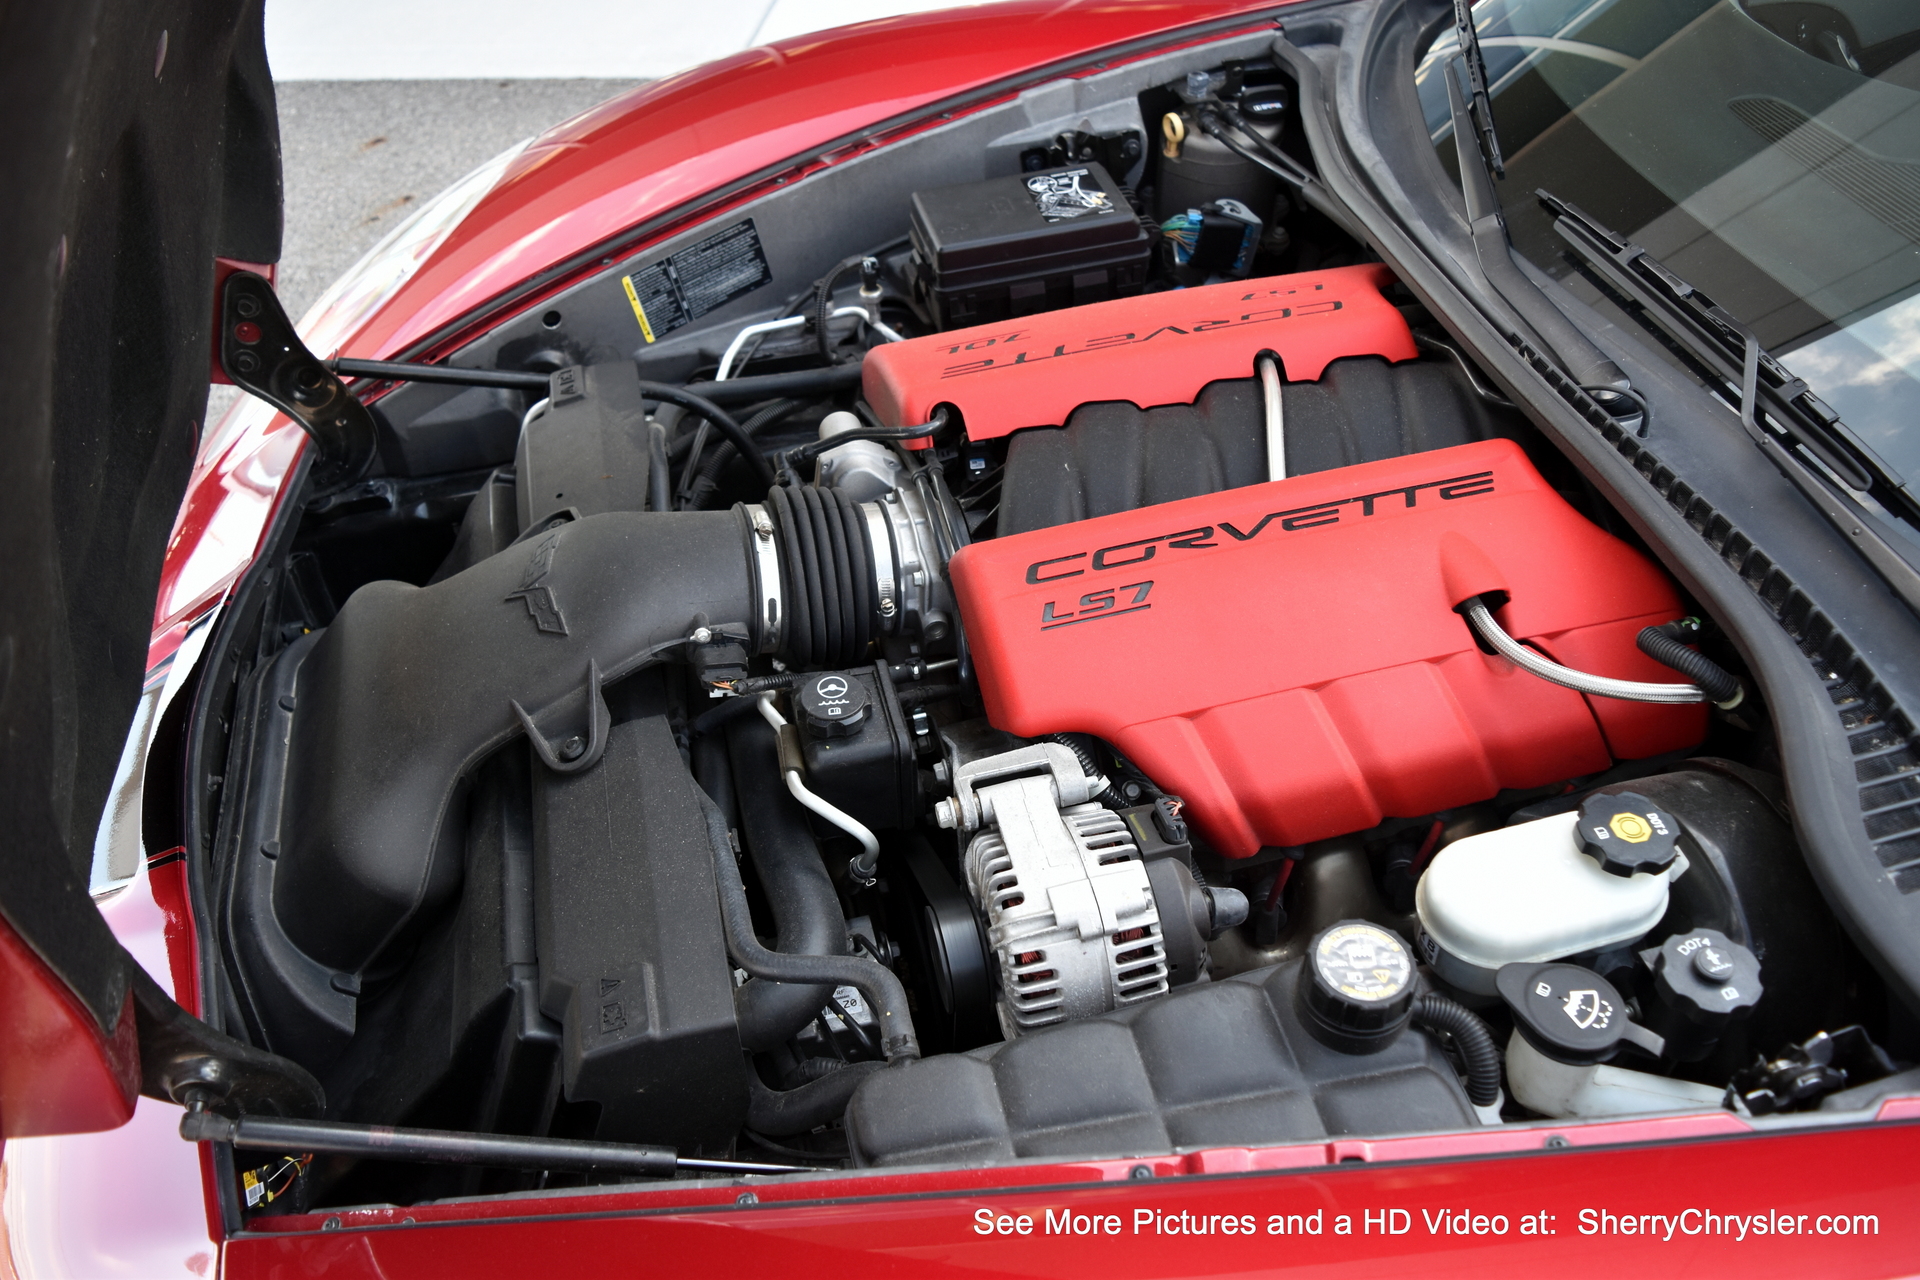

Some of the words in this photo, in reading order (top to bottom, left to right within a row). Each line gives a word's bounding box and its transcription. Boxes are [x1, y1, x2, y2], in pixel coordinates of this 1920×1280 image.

[940, 301, 1343, 379] CORVETTE
[1025, 470, 1495, 585] CORVETTE
[1041, 580, 1155, 624] LS7
